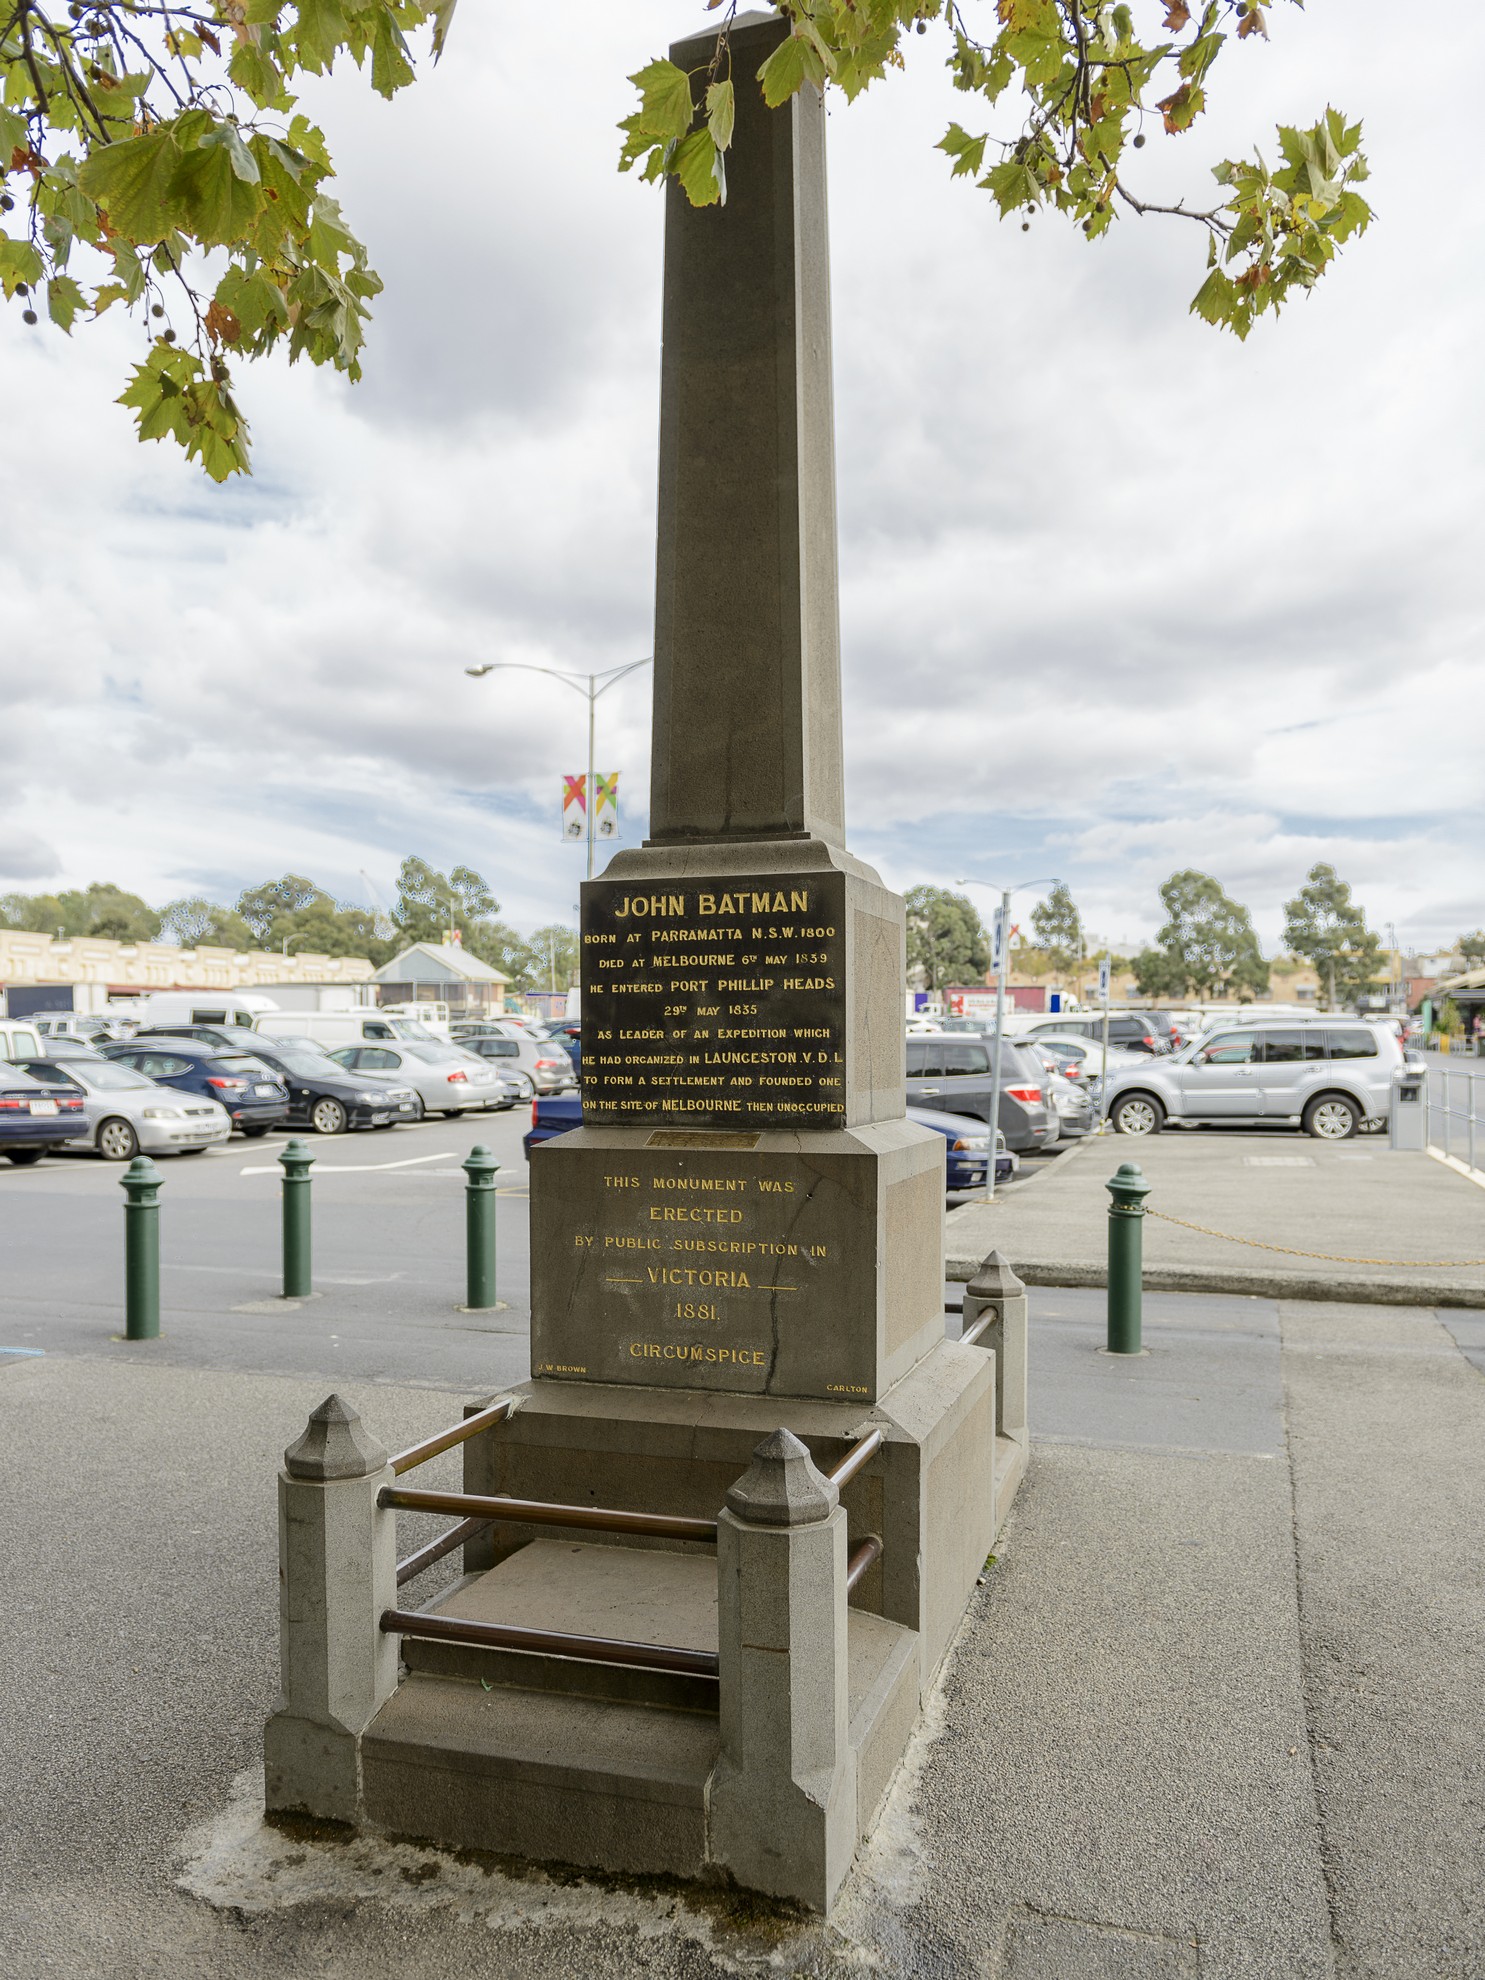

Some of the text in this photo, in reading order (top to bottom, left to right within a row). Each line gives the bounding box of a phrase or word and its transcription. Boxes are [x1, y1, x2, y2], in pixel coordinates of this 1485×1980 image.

[615, 891, 808, 918] JOHN BATMAN
[584, 934, 616, 943] BORN
[626, 933, 642, 943] AT
[651, 928, 742, 942] PARRAMATTA
[800, 927, 835, 938] 1800
[599, 959, 624, 968] DIED
[632, 959, 645, 968] AT
[653, 954, 735, 967] MELBOURNE
[765, 955, 788, 965] MAY
[796, 953, 828, 964] 1839
[590, 977, 835, 993] HE ENTERED PORT PHILLIP HEADS
[697, 1006, 720, 1016] MAY
[729, 1004, 757, 1015] 1835
[597, 1028, 830, 1040] AS LEADER OF AN EXPEDITION WHICH
[582, 1056, 595, 1065] HE
[600, 1056, 621, 1065] HAD
[625, 1055, 684, 1065] ORGANIZED
[689, 1055, 699, 1064] IN
[704, 1051, 797, 1064] LAUNCESTON
[584, 1076, 598, 1084] TO
[604, 1076, 633, 1085] FORM
[638, 1076, 646, 1085] A
[651, 1076, 724, 1086] SETTLEMENT
[730, 1077, 752, 1086] AND
[759, 1077, 812, 1086] FOUNDED
[819, 1077, 841, 1086] ONE
[582, 1100, 845, 1113] ON THE SITE OF MELBOURNE THEN UNOCCUPIED
[604, 1176, 794, 1193] THIS MONUMENT WAS
[650, 1206, 743, 1224] ERECTED
[575, 1236, 827, 1257] BY PUBLIC SUBSCRIPTION IN
[647, 1267, 751, 1288] VICTORIA
[630, 1343, 766, 1366] CIRCUMSPICE
[556, 1365, 586, 1373] BROWN
[826, 1384, 868, 1394] CARLTON
